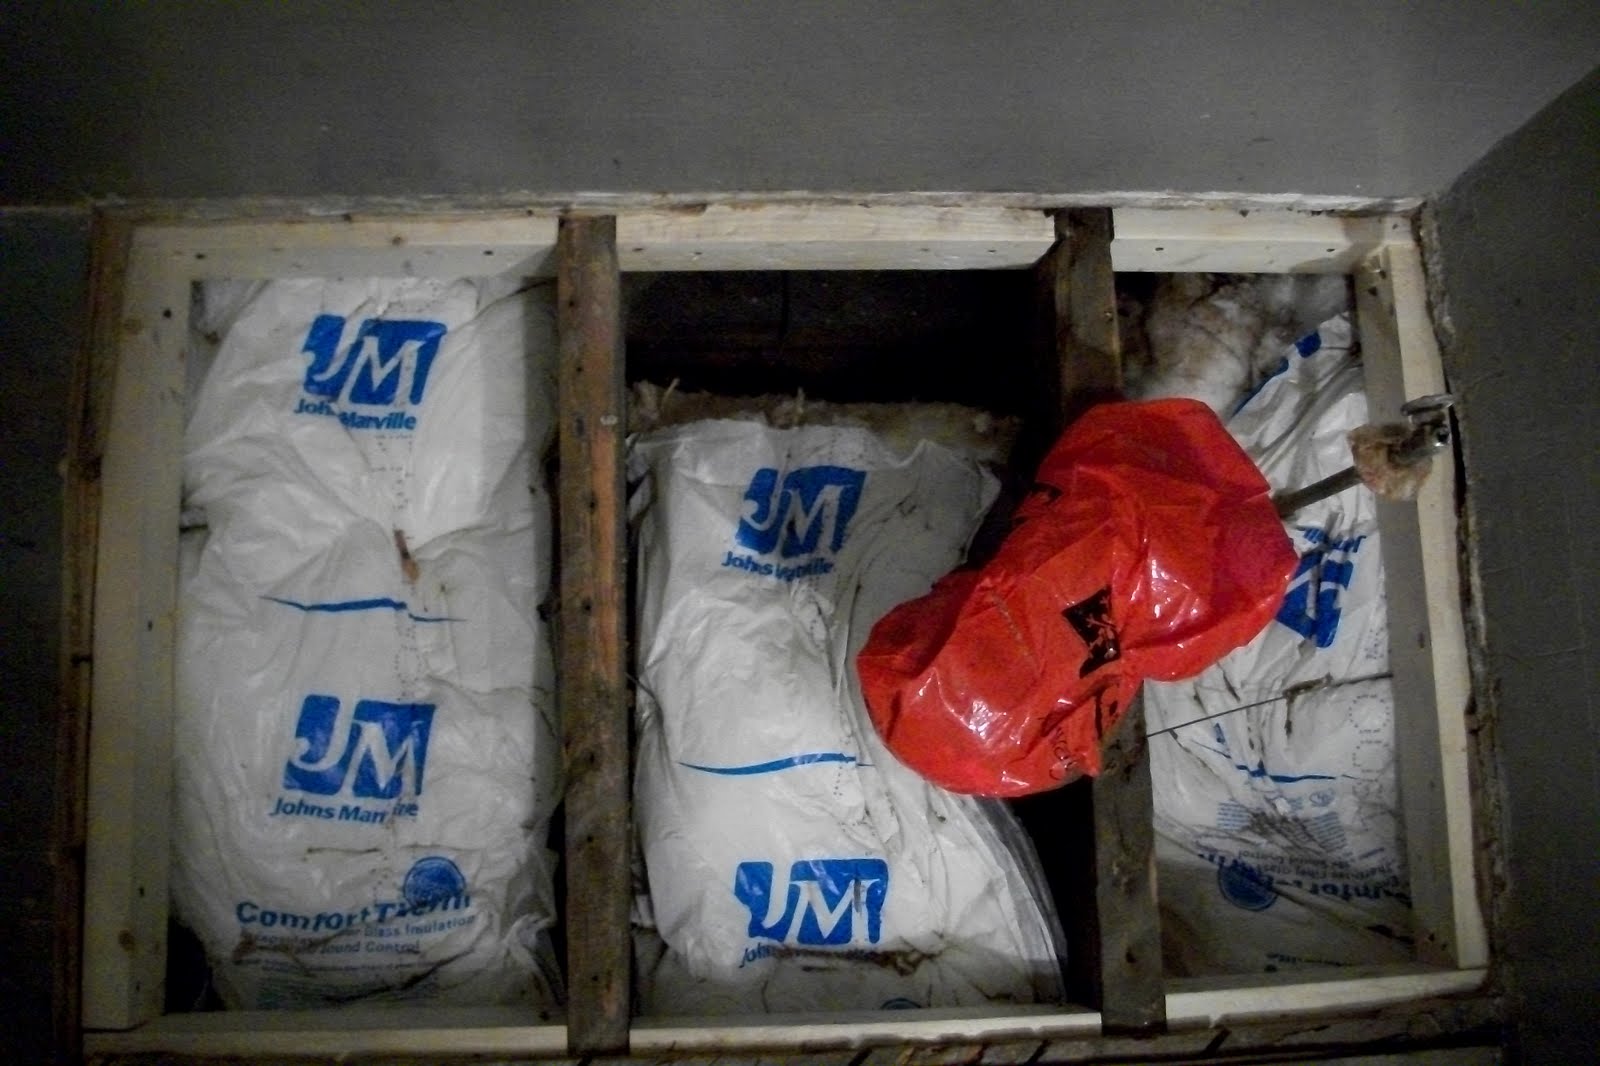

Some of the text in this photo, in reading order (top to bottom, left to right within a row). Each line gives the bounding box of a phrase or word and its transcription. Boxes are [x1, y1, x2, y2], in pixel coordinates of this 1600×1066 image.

[302, 314, 448, 406] JM
[294, 398, 338, 416] Joh
[735, 465, 868, 558] JM
[721, 551, 773, 575] Johns
[283, 694, 437, 799] JM
[269, 797, 335, 819] Johns
[733, 858, 890, 946] JM
[405, 914, 476, 936] Insulation
[365, 940, 421, 956] Control
[738, 942, 777, 969] John
